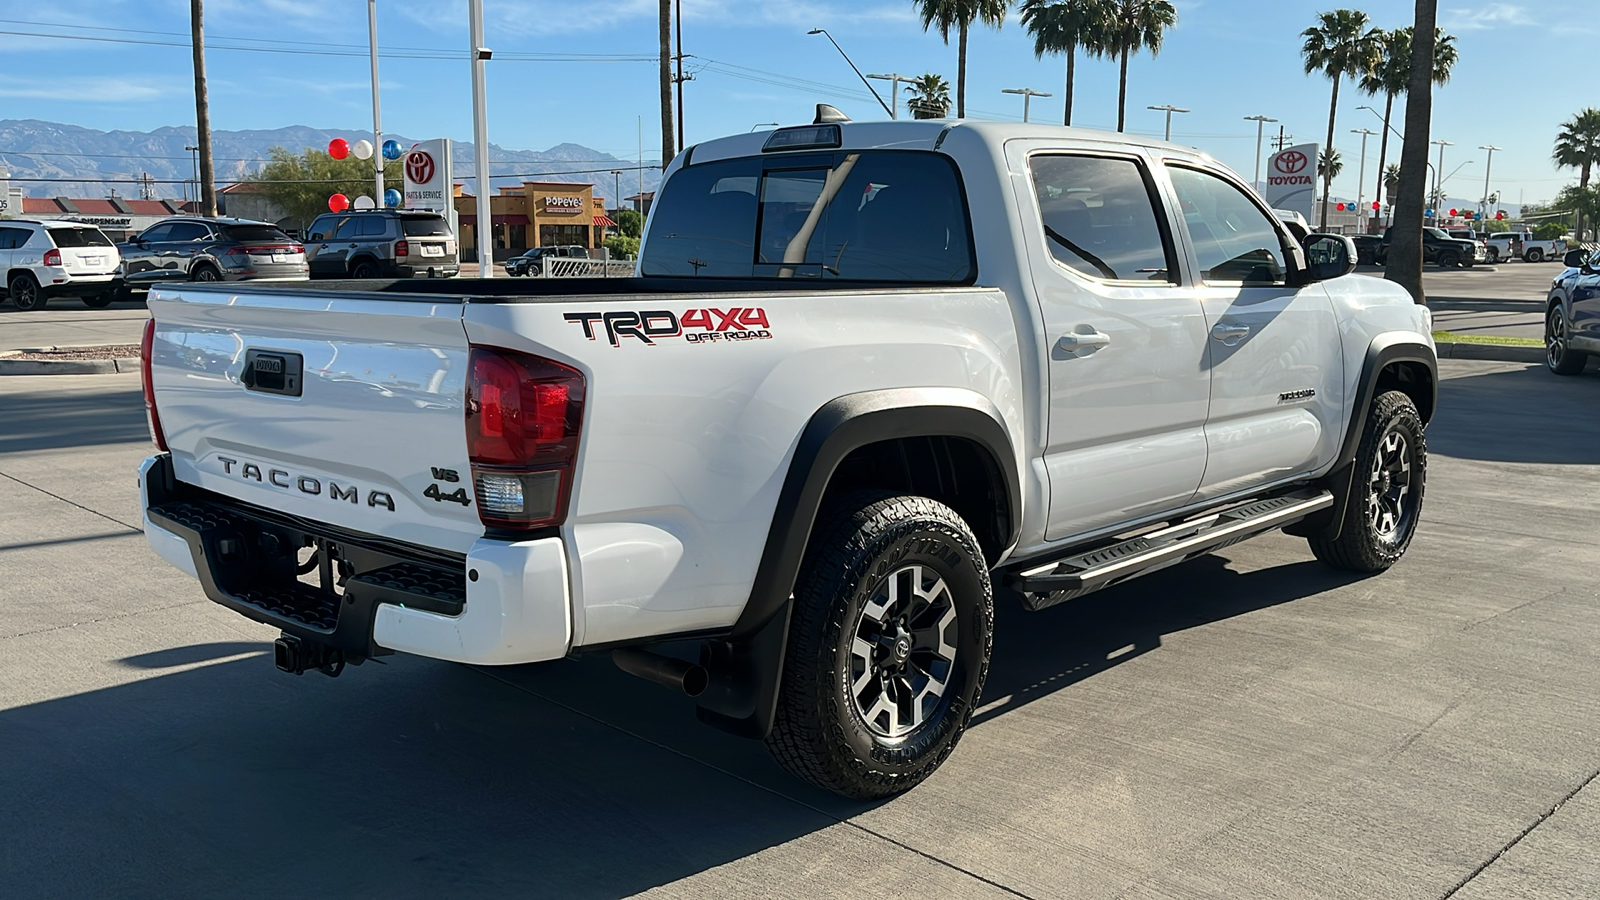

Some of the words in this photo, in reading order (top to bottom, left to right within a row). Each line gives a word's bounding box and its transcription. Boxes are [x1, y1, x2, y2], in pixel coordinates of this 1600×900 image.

[1268, 175, 1312, 185] TOYOTA
[406, 191, 418, 199] PARTS
[423, 190, 442, 199] SERVICE
[80, 217, 131, 225] DISPENSARY
[563, 310, 682, 348] TRD
[685, 332, 721, 344] OFF
[723, 329, 773, 342] ROAD
[430, 466, 460, 483] V6
[217, 456, 396, 512] TACOMA
